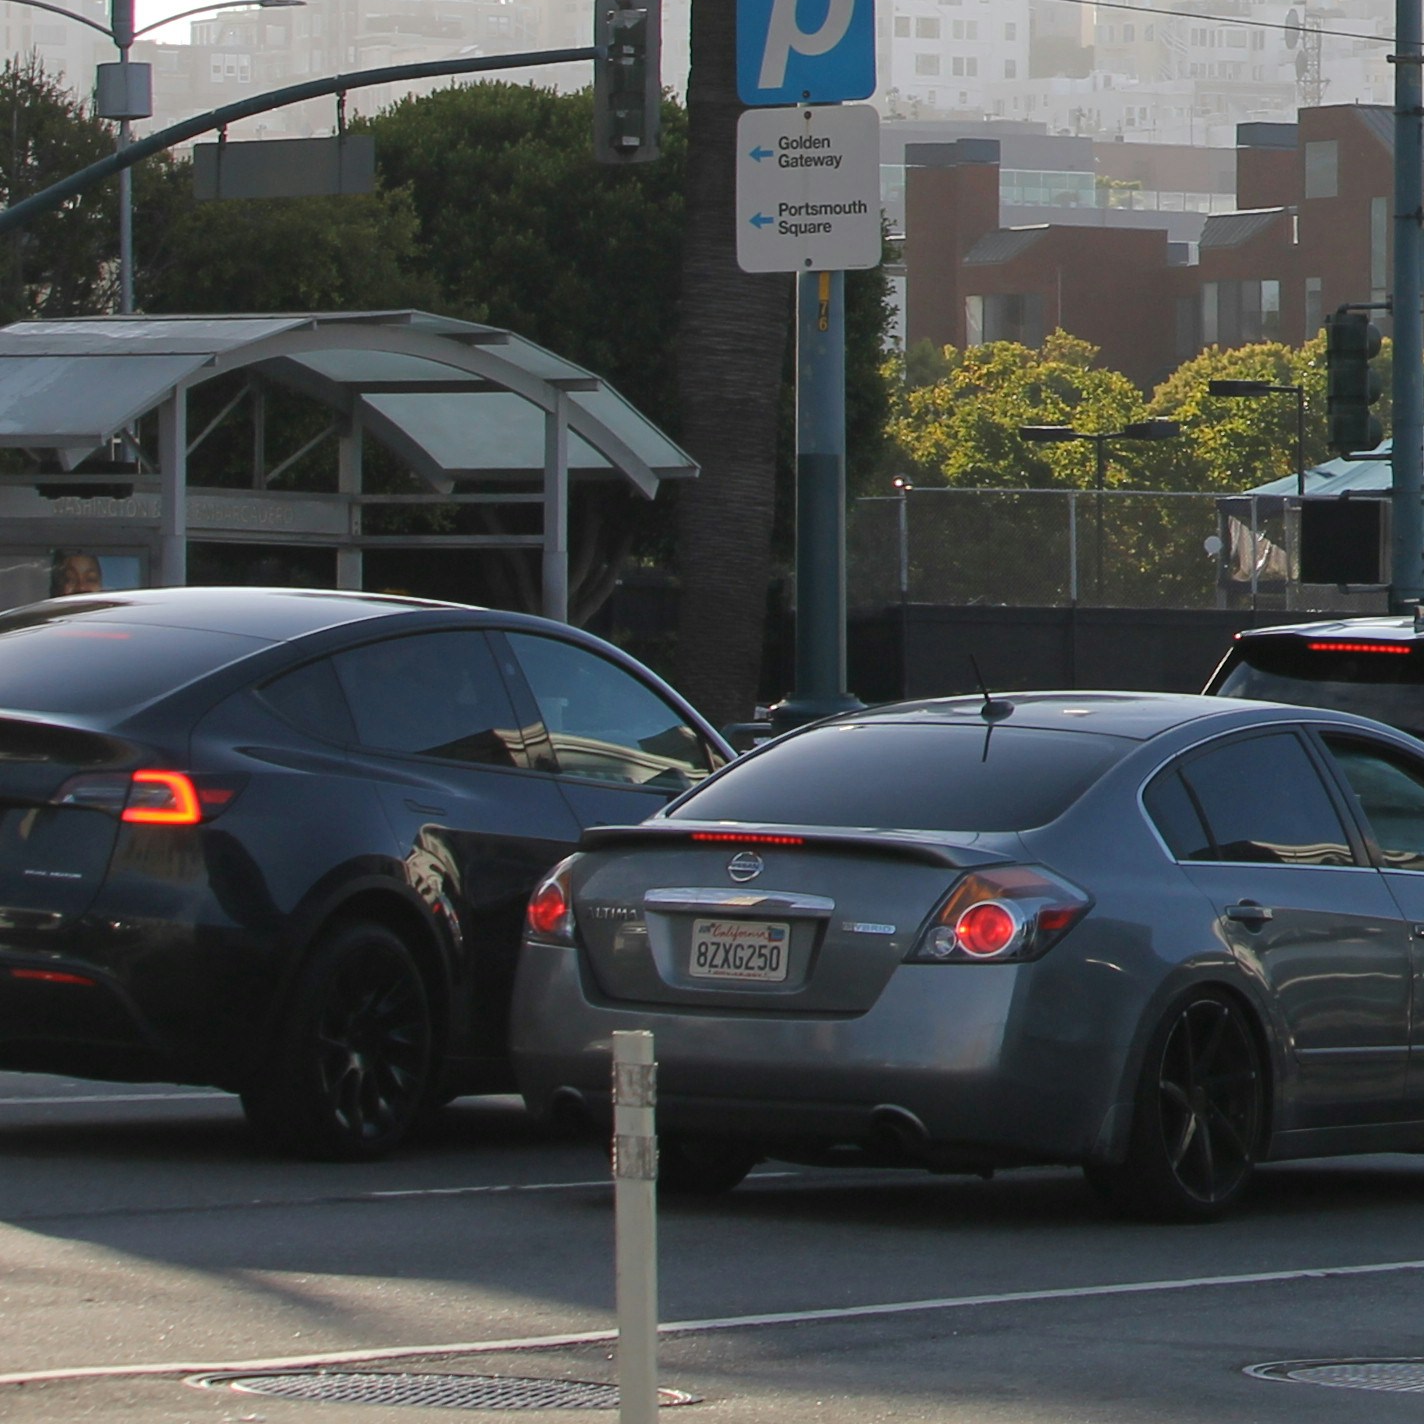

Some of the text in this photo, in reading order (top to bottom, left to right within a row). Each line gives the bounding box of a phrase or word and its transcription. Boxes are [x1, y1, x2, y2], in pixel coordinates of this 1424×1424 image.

[778, 136, 830, 150] Golden
[778, 153, 842, 169] Gateway
[778, 200, 867, 217] Portsmouth
[778, 220, 832, 237] Square
[713, 923, 767, 942] California
[697, 941, 780, 972] 8ZXG250
